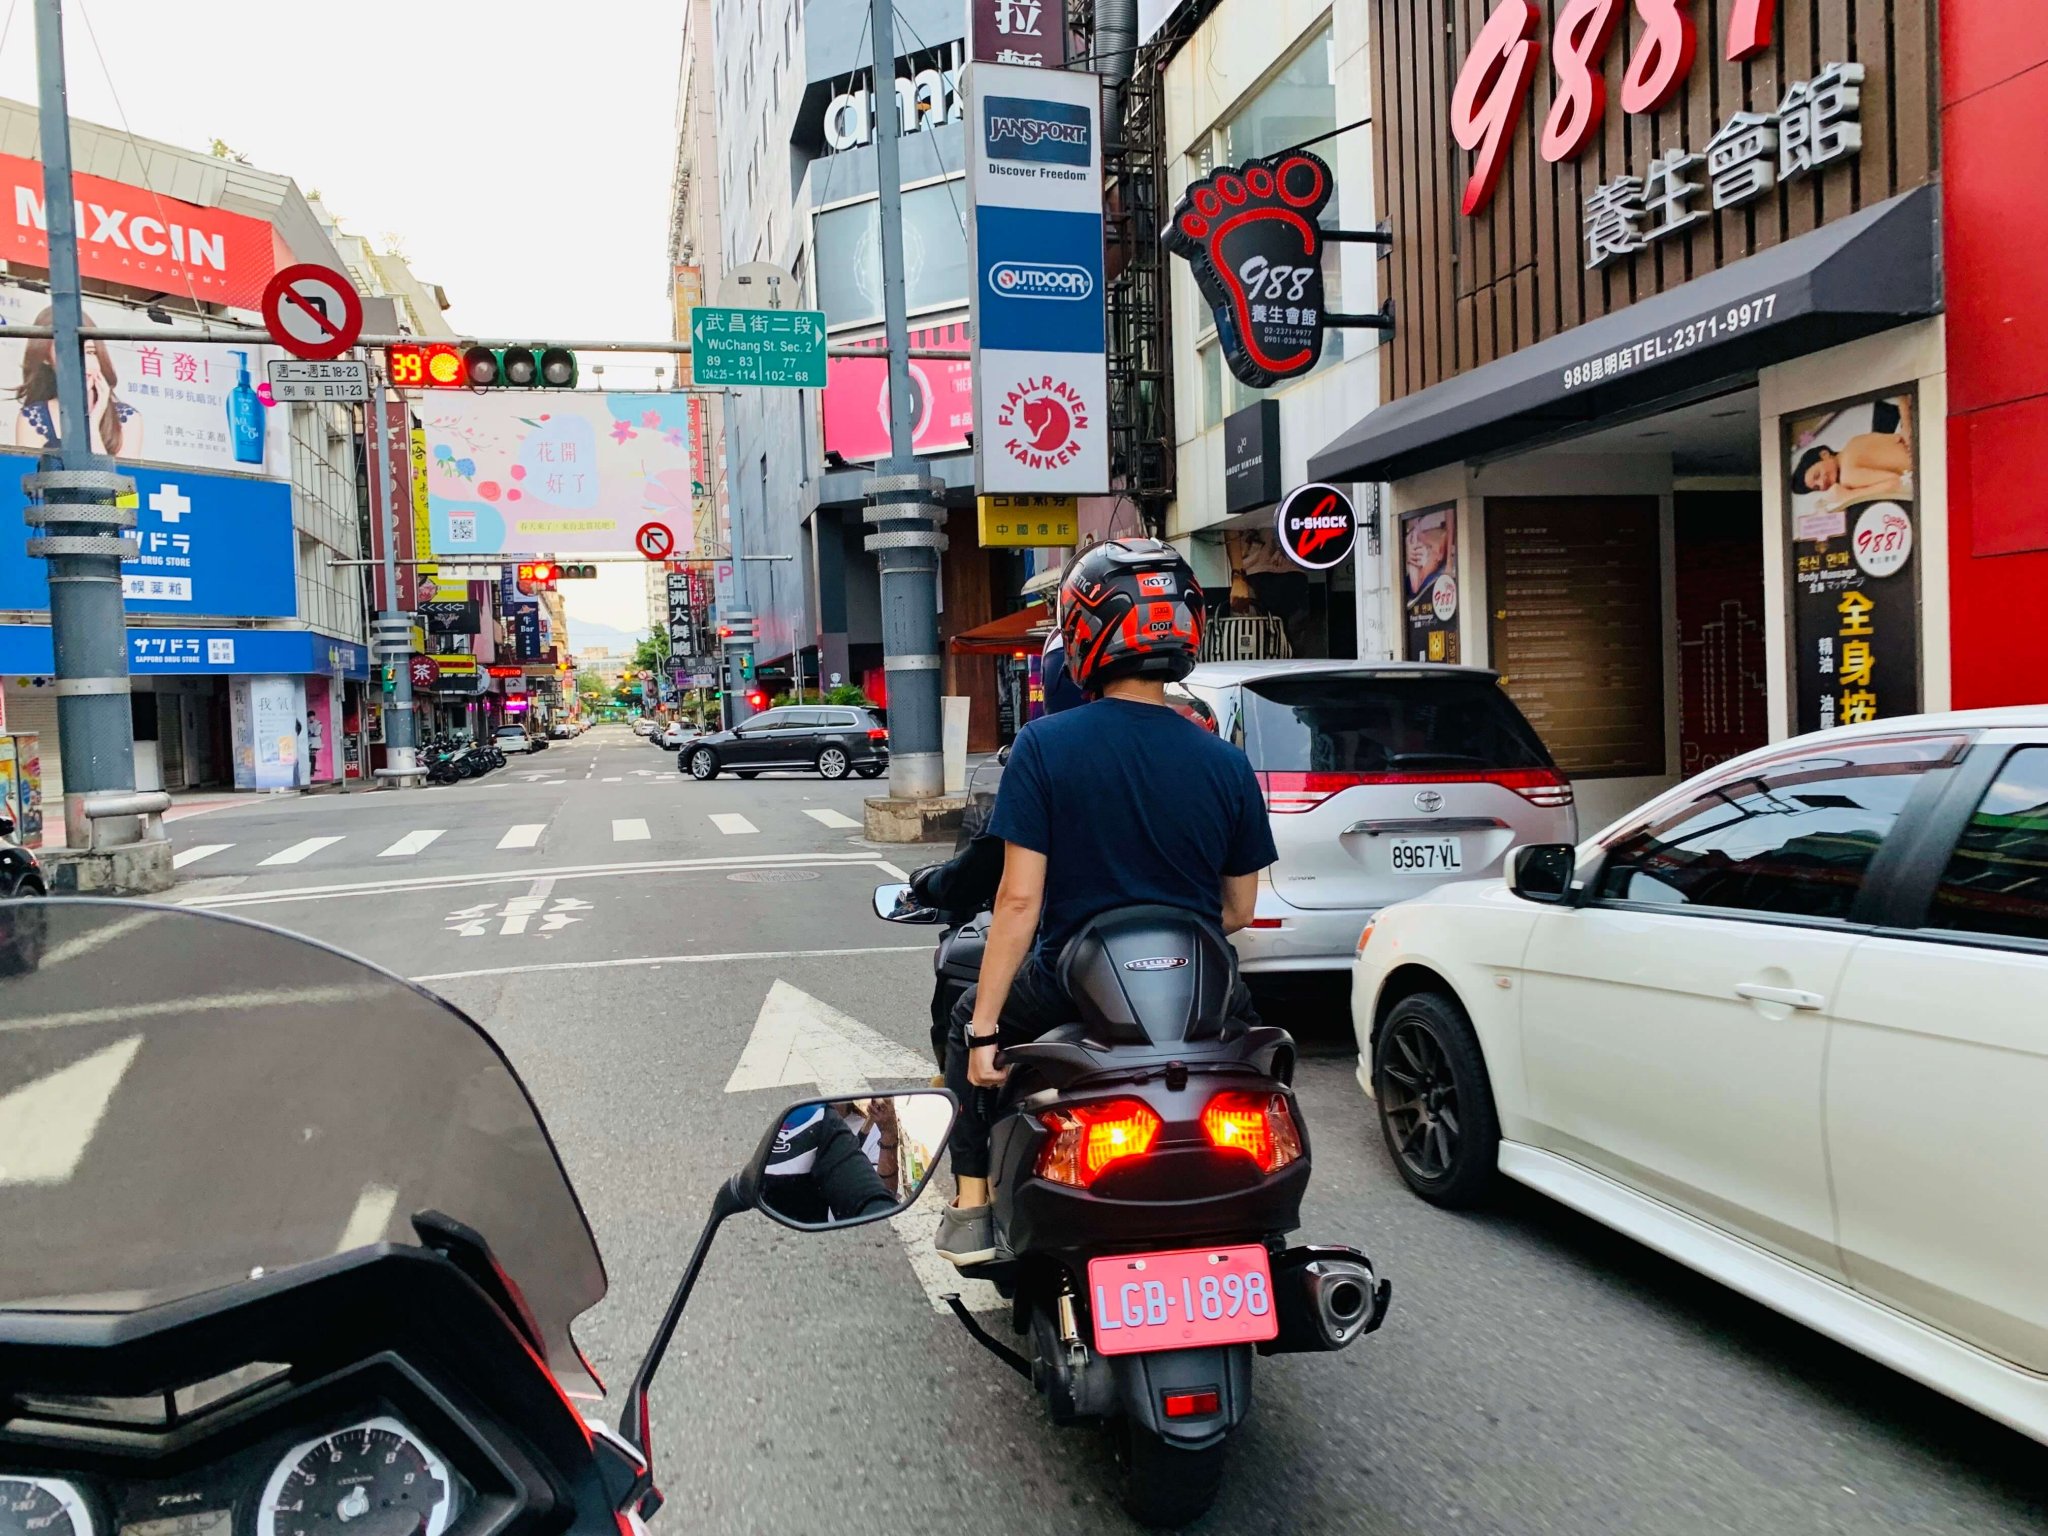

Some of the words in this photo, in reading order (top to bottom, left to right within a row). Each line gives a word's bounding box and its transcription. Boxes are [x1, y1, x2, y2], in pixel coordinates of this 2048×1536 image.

[989, 163, 1037, 178] Discover
[1040, 168, 1087, 181] Freedom
[1583, 62, 1866, 271] 養生會館
[121, 257, 227, 287] ACADEMY
[1239, 255, 1315, 301] 988
[997, 269, 1085, 294] OUTDOOR
[1251, 304, 1318, 326] 養生會館
[705, 313, 813, 335] 武昌街二段
[1264, 327, 1313, 336] 02-2371-9977
[707, 339, 761, 354] WuChang
[763, 340, 778, 352] St.
[780, 341, 803, 353] Sec.
[805, 342, 812, 353] 2
[393, 353, 422, 381] 39
[706, 355, 721, 366] 89
[739, 356, 753, 367] 83
[782, 358, 797, 368] 77
[764, 371, 809, 382] 102-68
[998, 375, 1088, 430] FJALLRAVEN
[536, 442, 577, 463] 花開
[1005, 439, 1081, 471] KANKEN
[546, 473, 585, 494] 好了
[996, 523, 1070, 536] 中國信託
[1290, 513, 1348, 531] G-SHOCK
[123, 529, 191, 555] ツドラ
[141, 555, 164, 566] DRUG
[165, 556, 191, 568] STORE
[520, 566, 533, 579] 39
[718, 565, 734, 583] P
[1144, 577, 1171, 587] KYT
[520, 625, 535, 633] Bar
[1151, 621, 1171, 631] DOT
[134, 638, 200, 654] サツドラ
[182, 655, 201, 664] STORE
[413, 664, 431, 680] 茶
[361, 1443, 372, 1455] 7
[330, 1451, 342, 1463] 6
[385, 1452, 397, 1464] 8
[304, 1474, 316, 1486] 5
[403, 1472, 415, 1485] 9
[293, 1499, 304, 1512] 4
